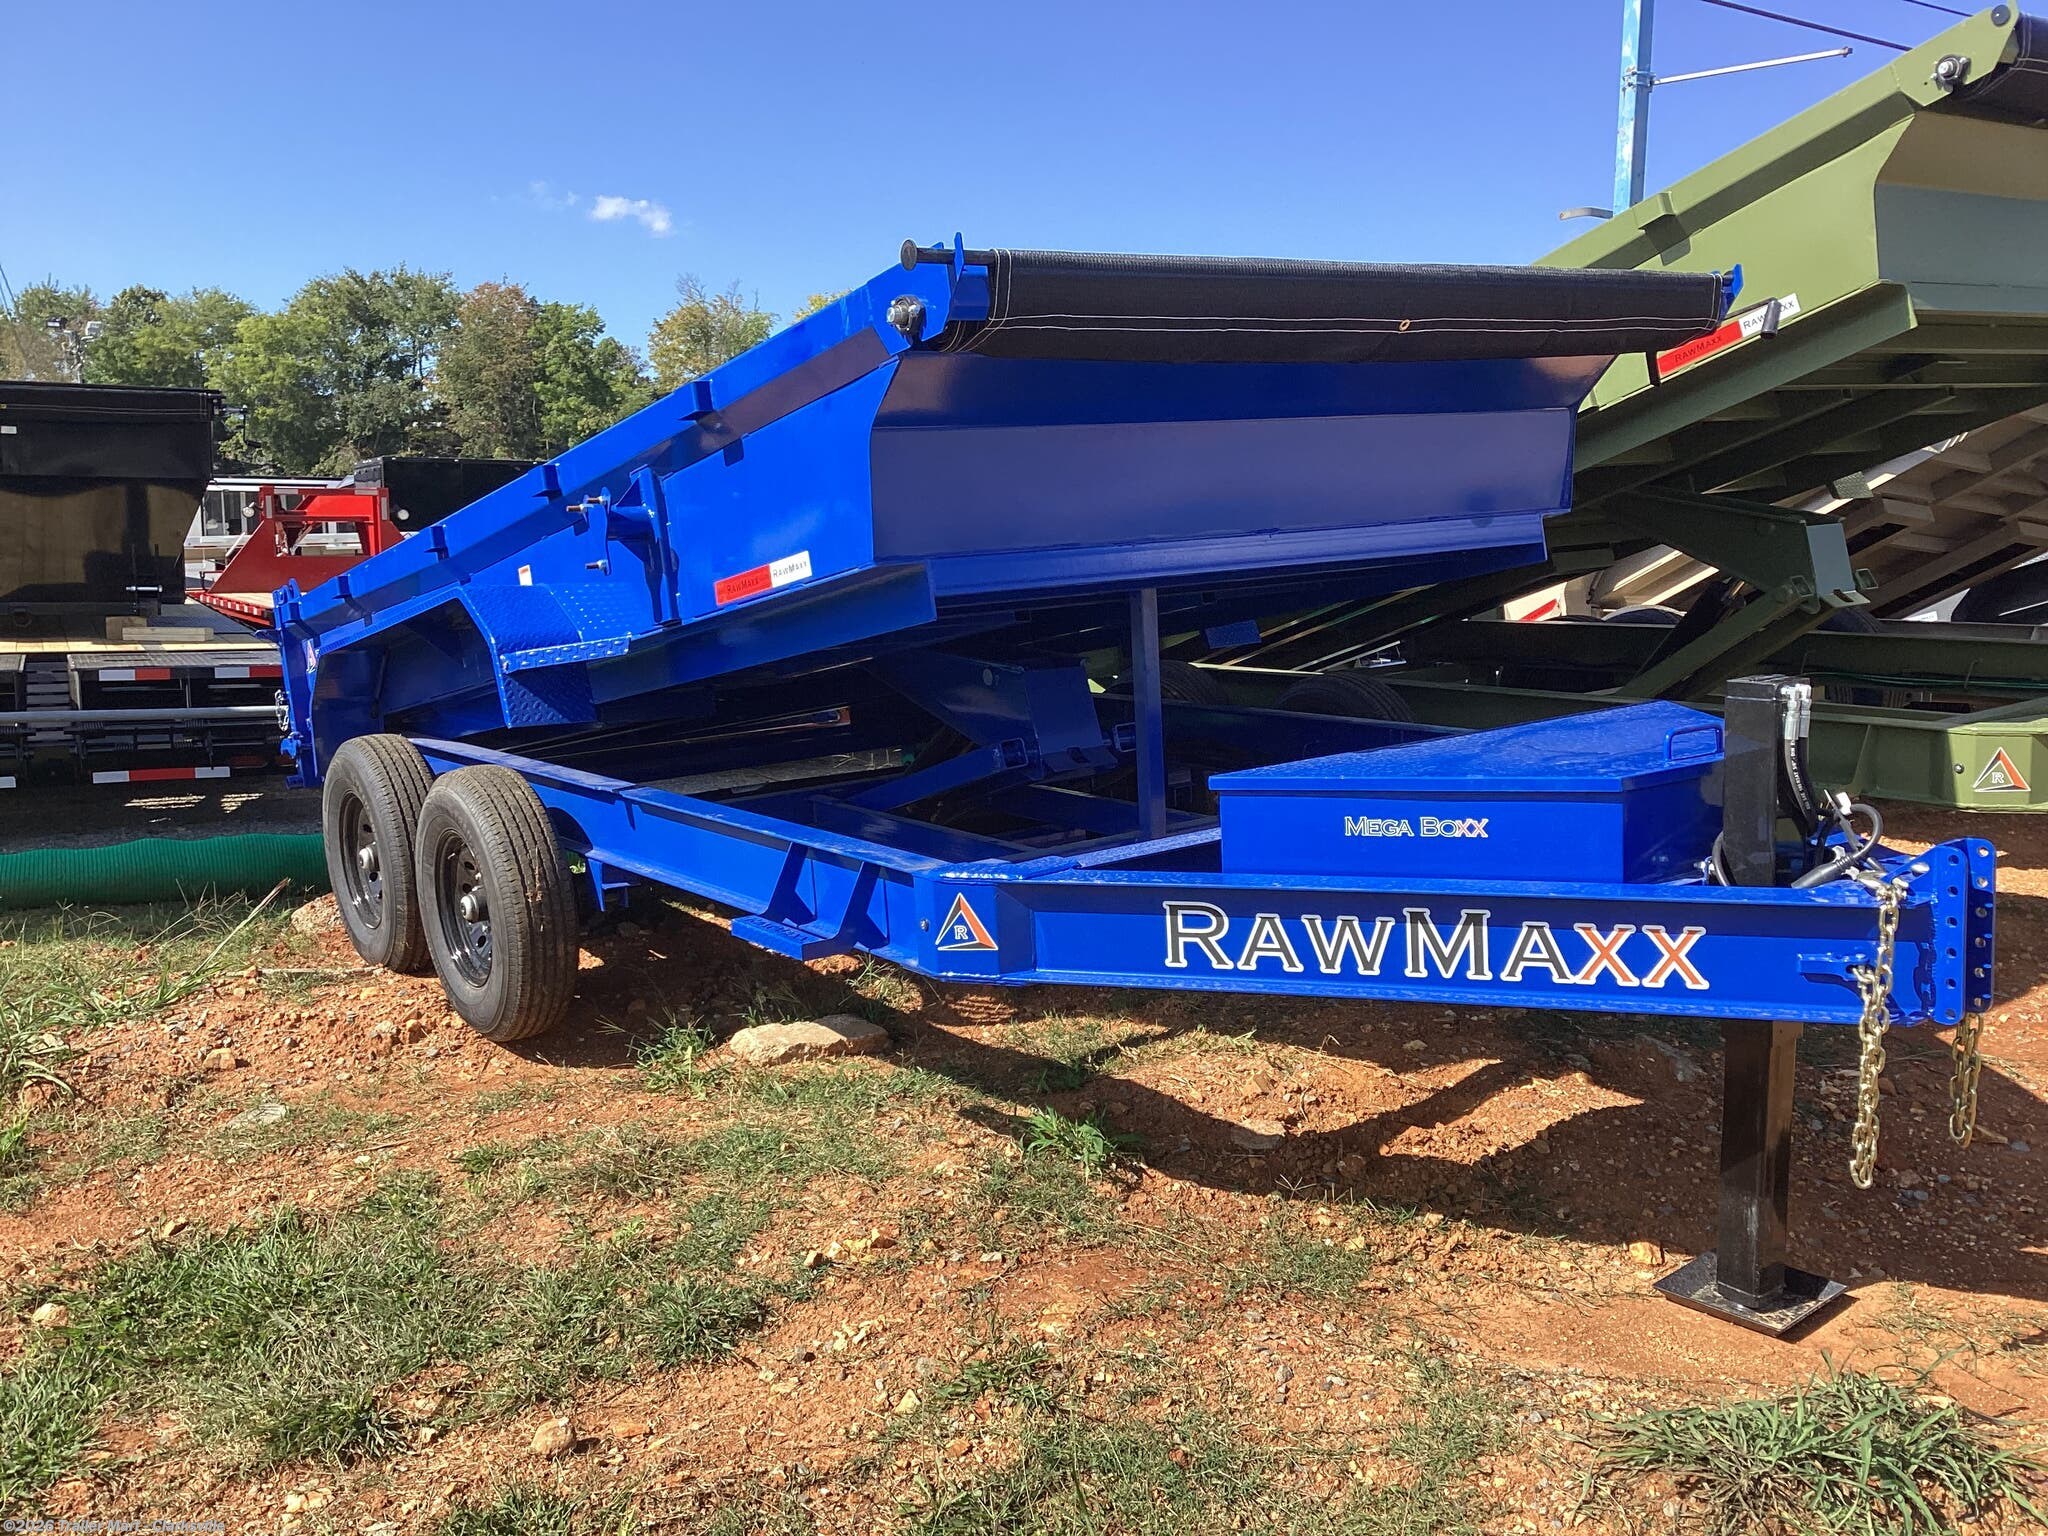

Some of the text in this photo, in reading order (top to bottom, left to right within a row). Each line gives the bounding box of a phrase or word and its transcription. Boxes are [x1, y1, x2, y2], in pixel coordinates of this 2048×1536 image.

[1674, 299, 1795, 363] RAWMAXX RAWXX
[1992, 771, 2005, 784] R
[1344, 815, 1489, 838] MEGA BOXX
[954, 925, 968, 940] R
[1162, 900, 1710, 990] RAWMAXX
